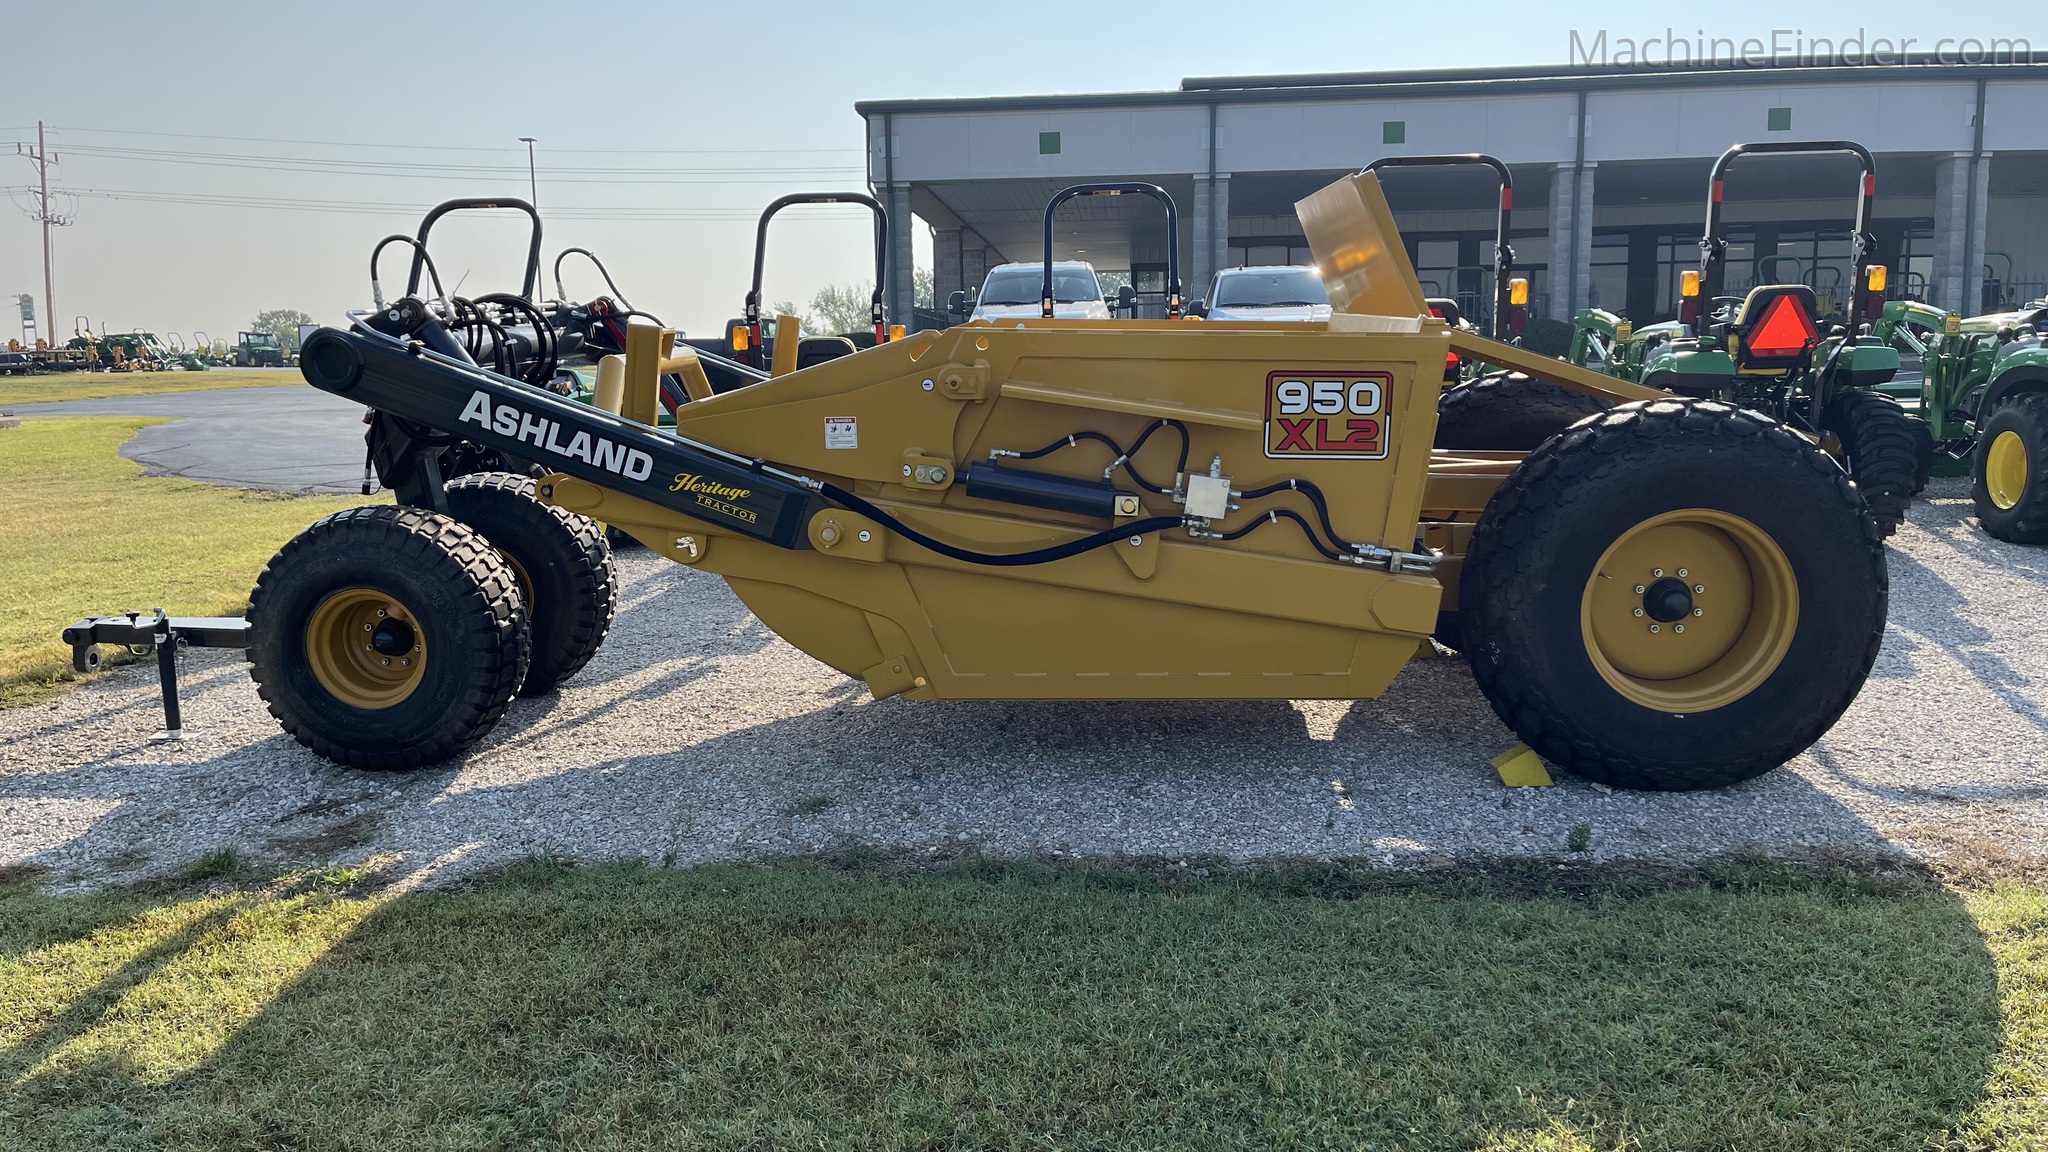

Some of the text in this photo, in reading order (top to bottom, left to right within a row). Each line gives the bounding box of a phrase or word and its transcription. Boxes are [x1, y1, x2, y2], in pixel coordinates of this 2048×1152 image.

[1276, 380, 1382, 415] 950
[458, 389, 654, 482] ASHLAND
[1274, 418, 1379, 451] XL2
[669, 473, 751, 501] Heritage
[697, 495, 757, 522] TRACTOR
